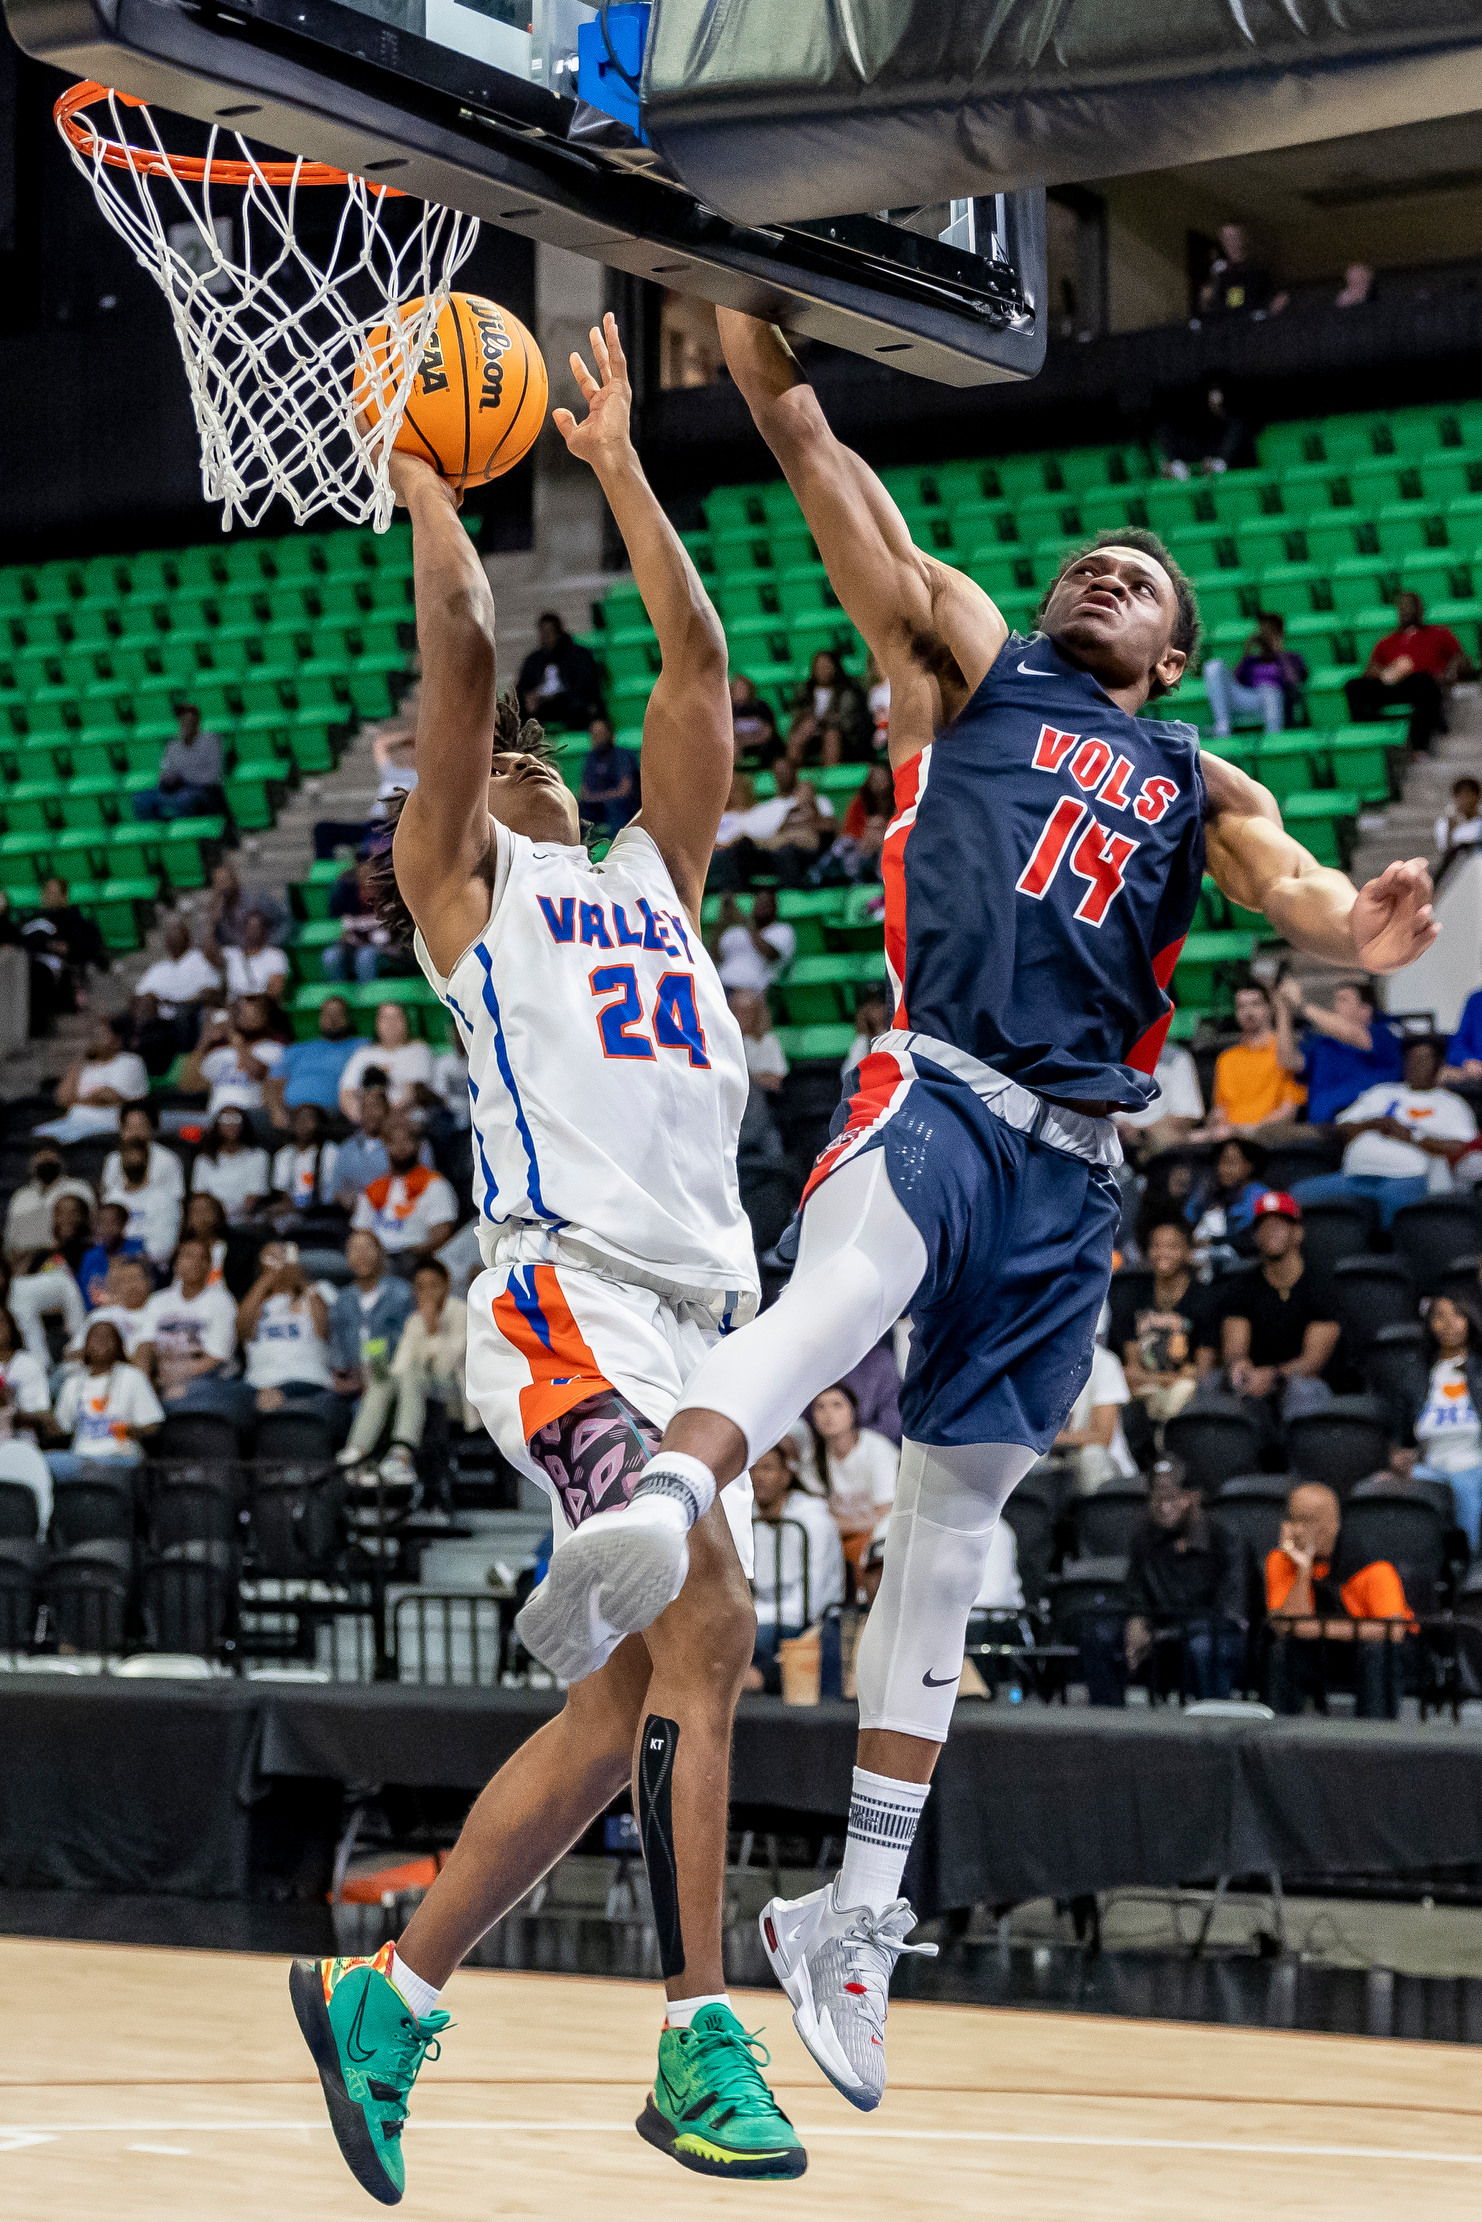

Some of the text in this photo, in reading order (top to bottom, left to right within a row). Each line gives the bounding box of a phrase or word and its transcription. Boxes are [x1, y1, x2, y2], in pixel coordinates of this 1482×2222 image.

[466, 298, 512, 409] Wilson
[1031, 723, 1180, 825] VOLS
[1015, 795, 1140, 928] 14
[588, 963, 711, 1069] 24
[650, 1738, 664, 1750] KT
